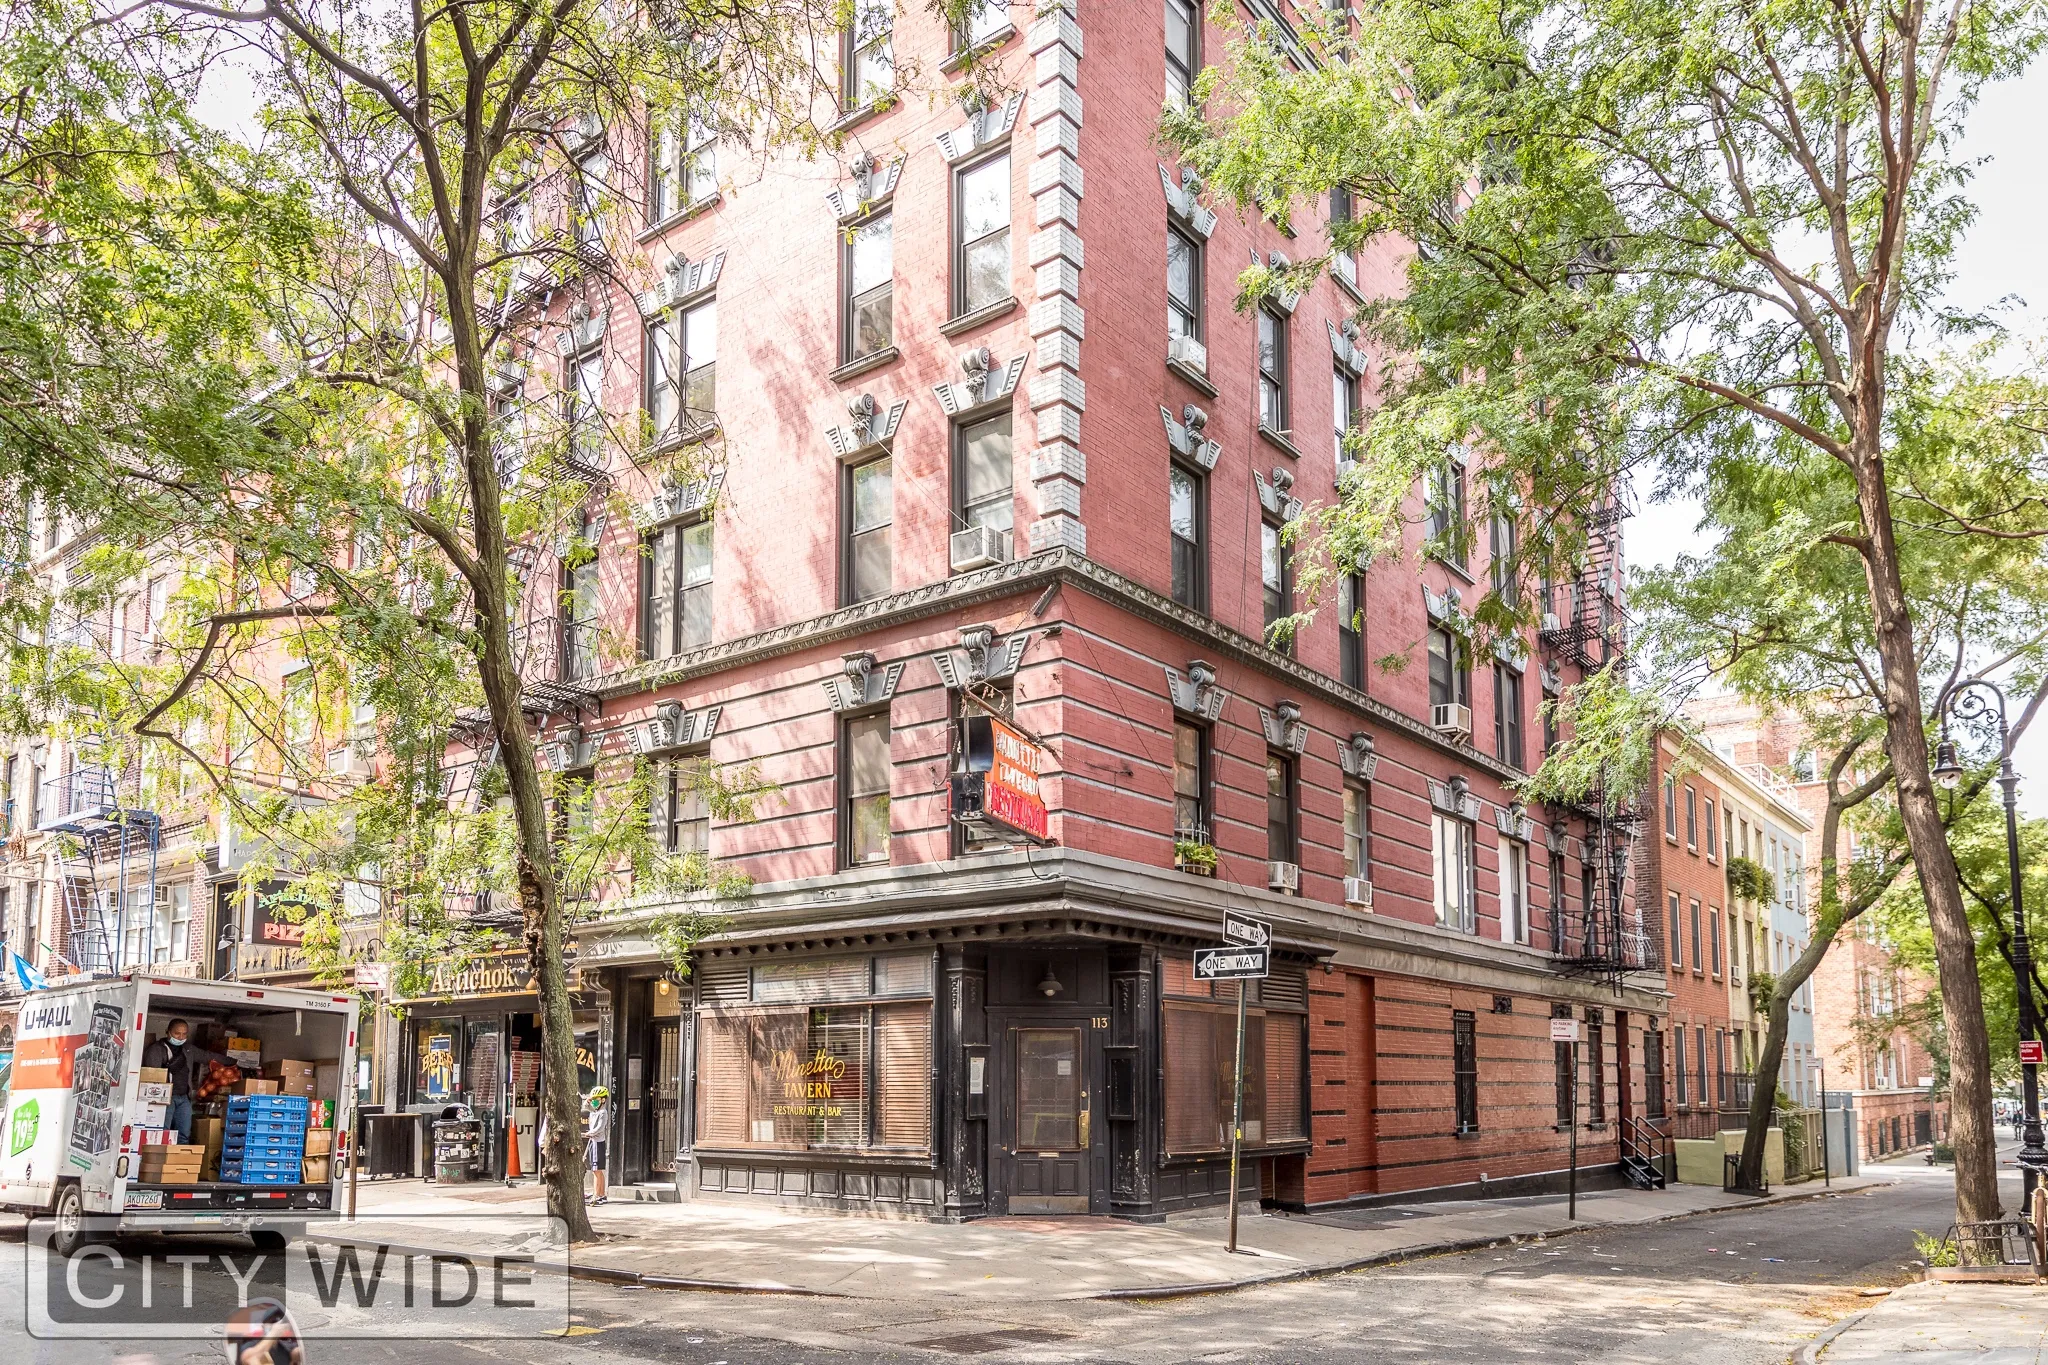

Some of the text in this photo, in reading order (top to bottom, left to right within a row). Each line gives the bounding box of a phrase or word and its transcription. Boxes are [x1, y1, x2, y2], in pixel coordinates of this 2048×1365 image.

[1230, 922, 1244, 937] ONE
[1249, 928, 1264, 942] WAY
[1205, 956, 1258, 970] ONE WAY
[430, 961, 520, 993] Artichok
[24, 1005, 72, 1031] U-HAUL
[1091, 1017, 1108, 1029] 113
[421, 1051, 454, 1073] BEER
[770, 1047, 845, 1081] Minetta
[783, 1082, 832, 1098] TAVERN
[773, 1105, 842, 1117] RESTAURANT & BAR
